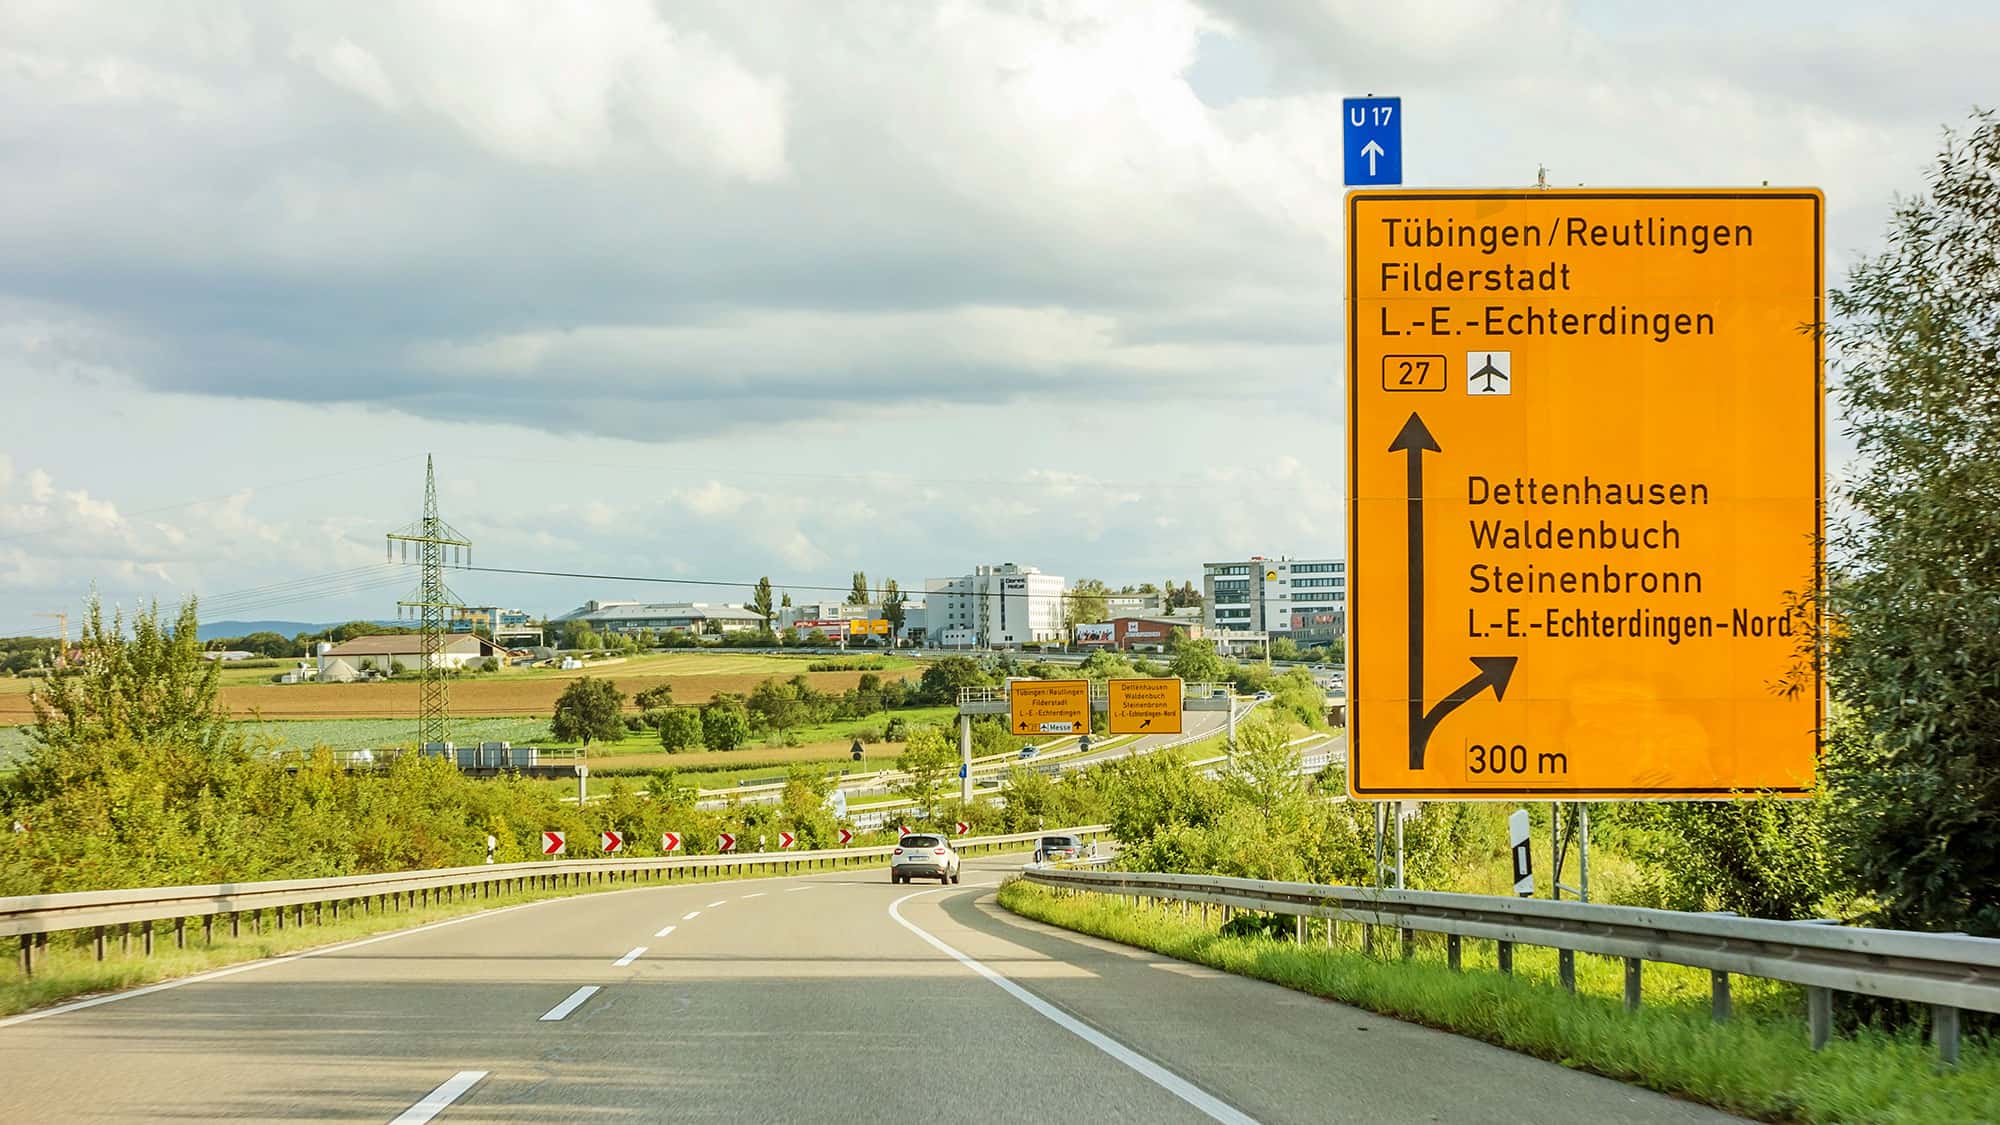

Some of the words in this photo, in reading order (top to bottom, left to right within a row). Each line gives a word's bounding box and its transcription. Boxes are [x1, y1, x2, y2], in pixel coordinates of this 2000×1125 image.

[1351, 106, 1365, 127] U
[1372, 106, 1393, 127] 17
[1381, 217, 1753, 255] Tübingen/Reutlingen
[1381, 261, 1570, 292] Filderstadt
[1381, 305, 1714, 343] L.-E.-Echterdingen
[1399, 361, 1430, 385] 27
[1468, 475, 1708, 505] Dettenhausen
[1469, 519, 1680, 550] Waldenbuch
[1469, 563, 1702, 594] Steinenbronn
[1468, 607, 1791, 645] L.-E.-Echterdingen-Nord
[1469, 744, 1527, 774] 300
[1538, 752, 1568, 774] m
